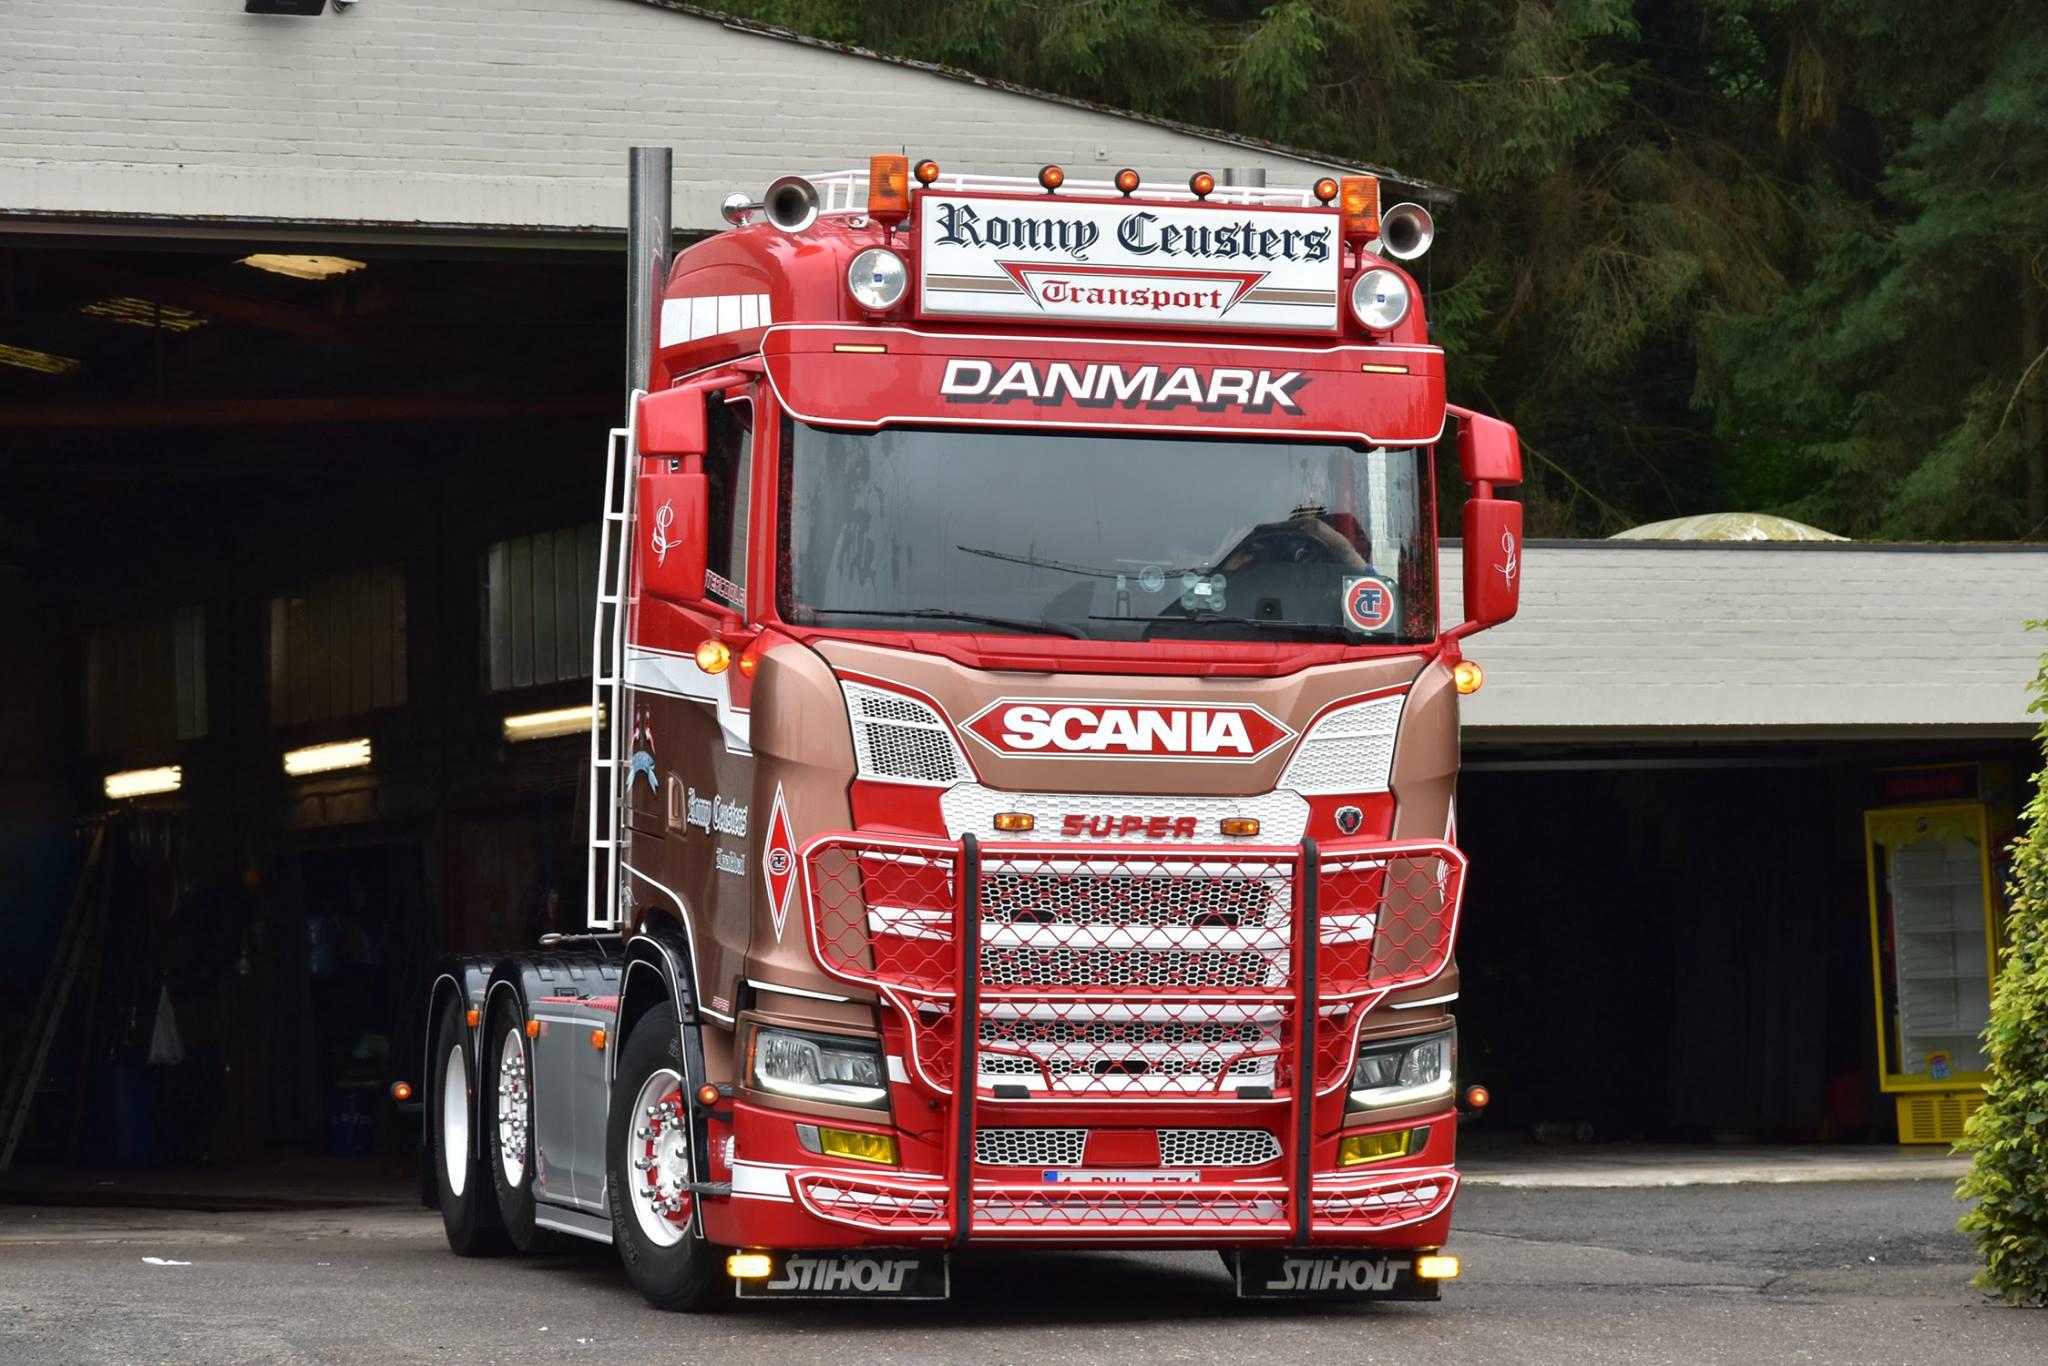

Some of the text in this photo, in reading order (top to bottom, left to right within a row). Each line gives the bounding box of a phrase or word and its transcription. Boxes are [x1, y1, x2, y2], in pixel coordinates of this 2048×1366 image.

[935, 203, 1331, 262] Ronny Ceusters
[1041, 279, 1224, 311] Transport
[939, 358, 1304, 411] DANMARK
[1001, 706, 1254, 753] SCANIA
[1060, 814, 1197, 838] SUPER
[767, 1259, 919, 1291] STIHOLT
[1266, 1259, 1411, 1291] STIHOLT
